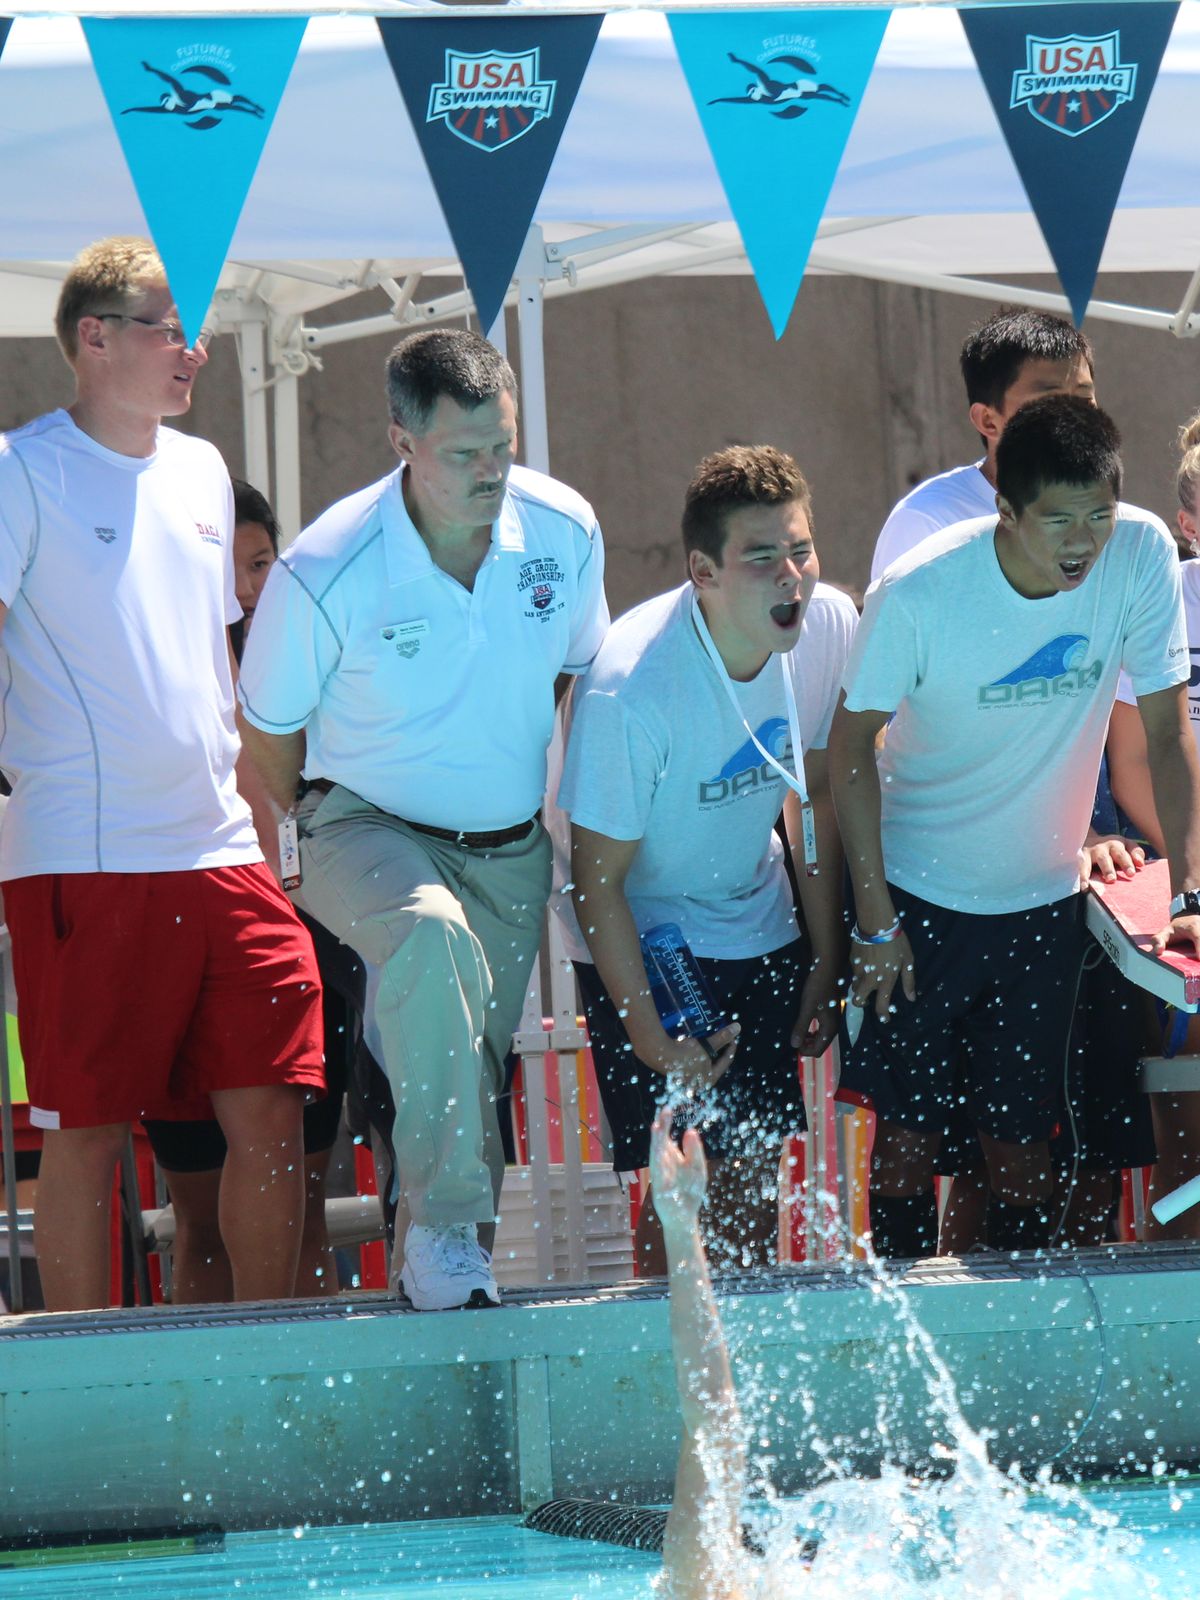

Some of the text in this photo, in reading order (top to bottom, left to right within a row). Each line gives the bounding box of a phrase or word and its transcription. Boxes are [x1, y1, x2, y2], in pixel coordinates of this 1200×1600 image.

[1040, 46, 1107, 74] USA
[457, 63, 526, 89] USA
[1023, 73, 1123, 92] SWIMMING
[440, 90, 542, 106] SWIMMING
[519, 563, 559, 580] AGE GROUP
[517, 571, 565, 592] CHAMPIONSHIPS
[396, 640, 420, 651] arena
